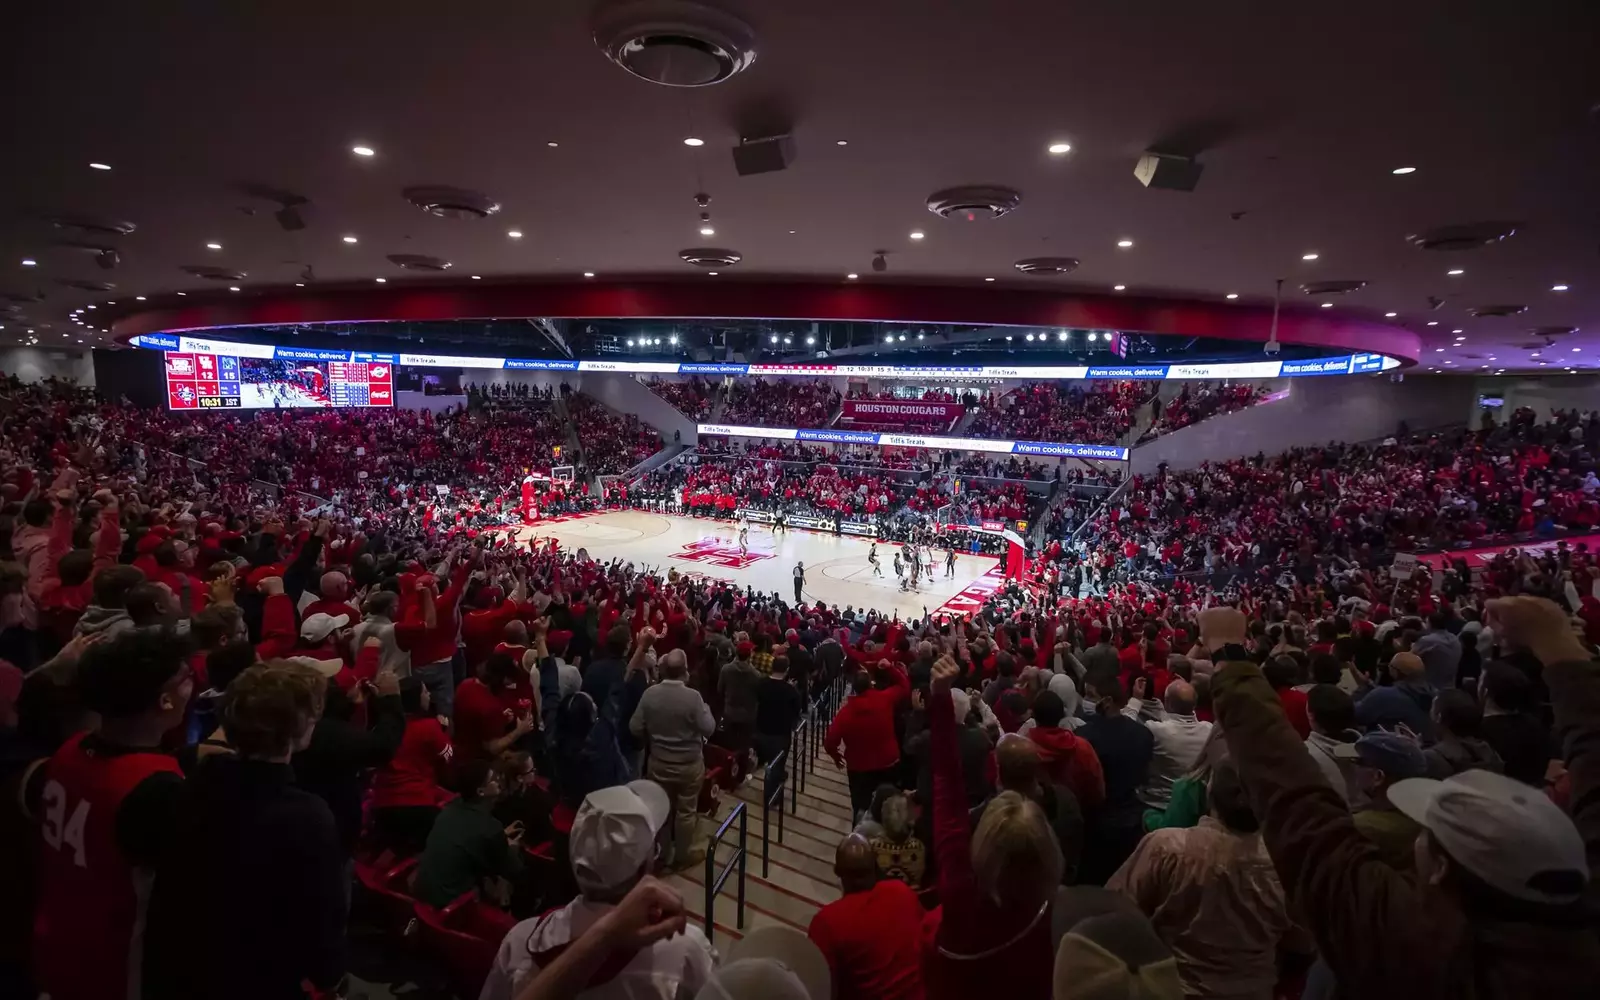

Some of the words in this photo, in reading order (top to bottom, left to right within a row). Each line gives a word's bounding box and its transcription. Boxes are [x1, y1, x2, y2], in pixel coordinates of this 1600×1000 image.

[276, 349, 294, 357] Warm
[295, 350, 318, 359] cookies,
[319, 351, 347, 360] delivered.
[524, 361, 547, 369] cookies,
[548, 361, 576, 369] delivered.
[720, 365, 745, 373] delivered.
[1283, 365, 1301, 373] Warm
[1301, 363, 1323, 372] cookies,
[1323, 361, 1348, 371] delivered.
[201, 371, 213, 379] 12
[223, 372, 235, 380] 15
[1108, 369, 1133, 377] cookies,
[1134, 368, 1164, 376] delivered.
[200, 398, 221, 406] 10:31
[855, 404, 899, 413] HOUSTON
[900, 405, 946, 415] COUGARS
[800, 431, 817, 439] Warm
[818, 432, 843, 441] cookies,
[844, 434, 875, 442] delivered.
[1017, 444, 1041, 452] Warm
[1042, 445, 1075, 455] cookies,
[1077, 447, 1118, 457] delivered.
[42, 779, 92, 869] 34
